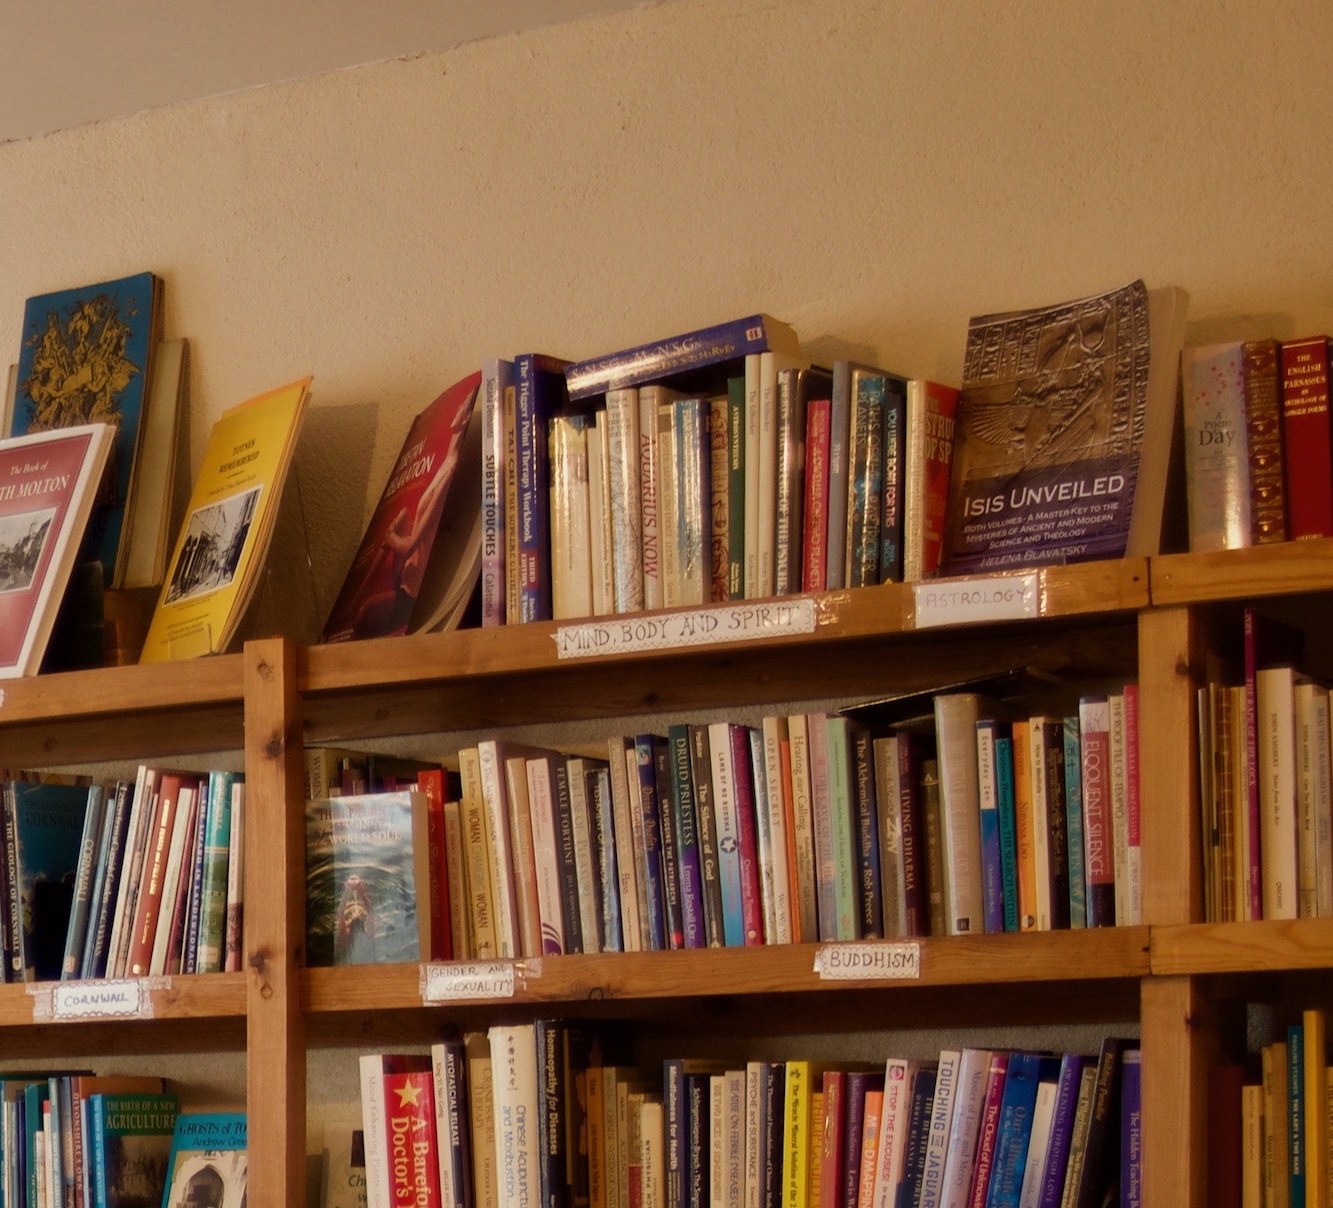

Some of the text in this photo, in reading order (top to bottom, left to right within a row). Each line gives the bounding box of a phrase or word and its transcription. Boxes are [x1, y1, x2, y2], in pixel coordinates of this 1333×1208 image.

[1287, 363, 1321, 375] ENGLISH
[1284, 376, 1326, 389] PARNASSUS
[1198, 430, 1236, 446] Day
[16, 475, 69, 498] MOLTON
[963, 475, 1125, 517] ISIS UNVEILED
[485, 455, 496, 556] SUBTLE TOUCHES
[642, 434, 658, 578] AQUARIUS NOW
[926, 588, 1026, 608] ASTROLOGY
[563, 605, 799, 650] MIND, BODY AND SPIRIT
[676, 739, 693, 845] DRUID PRIESTESS
[830, 951, 915, 969] BUDDHISM
[431, 964, 510, 978] GENDER AND
[445, 979, 513, 993] SEXUALITY
[64, 993, 129, 1008] CORNWALL
[933, 1059, 953, 1130] TOUCHING
[106, 1113, 176, 1130] AGRICULTURE
[179, 1121, 219, 1136] GHOSTS
[411, 1116, 428, 1132] A
[882, 1085, 899, 1182] STOP THE EXCUSES!
[391, 1116, 413, 1197] Doctor's
[923, 1150, 941, 1208] JAGUAR
